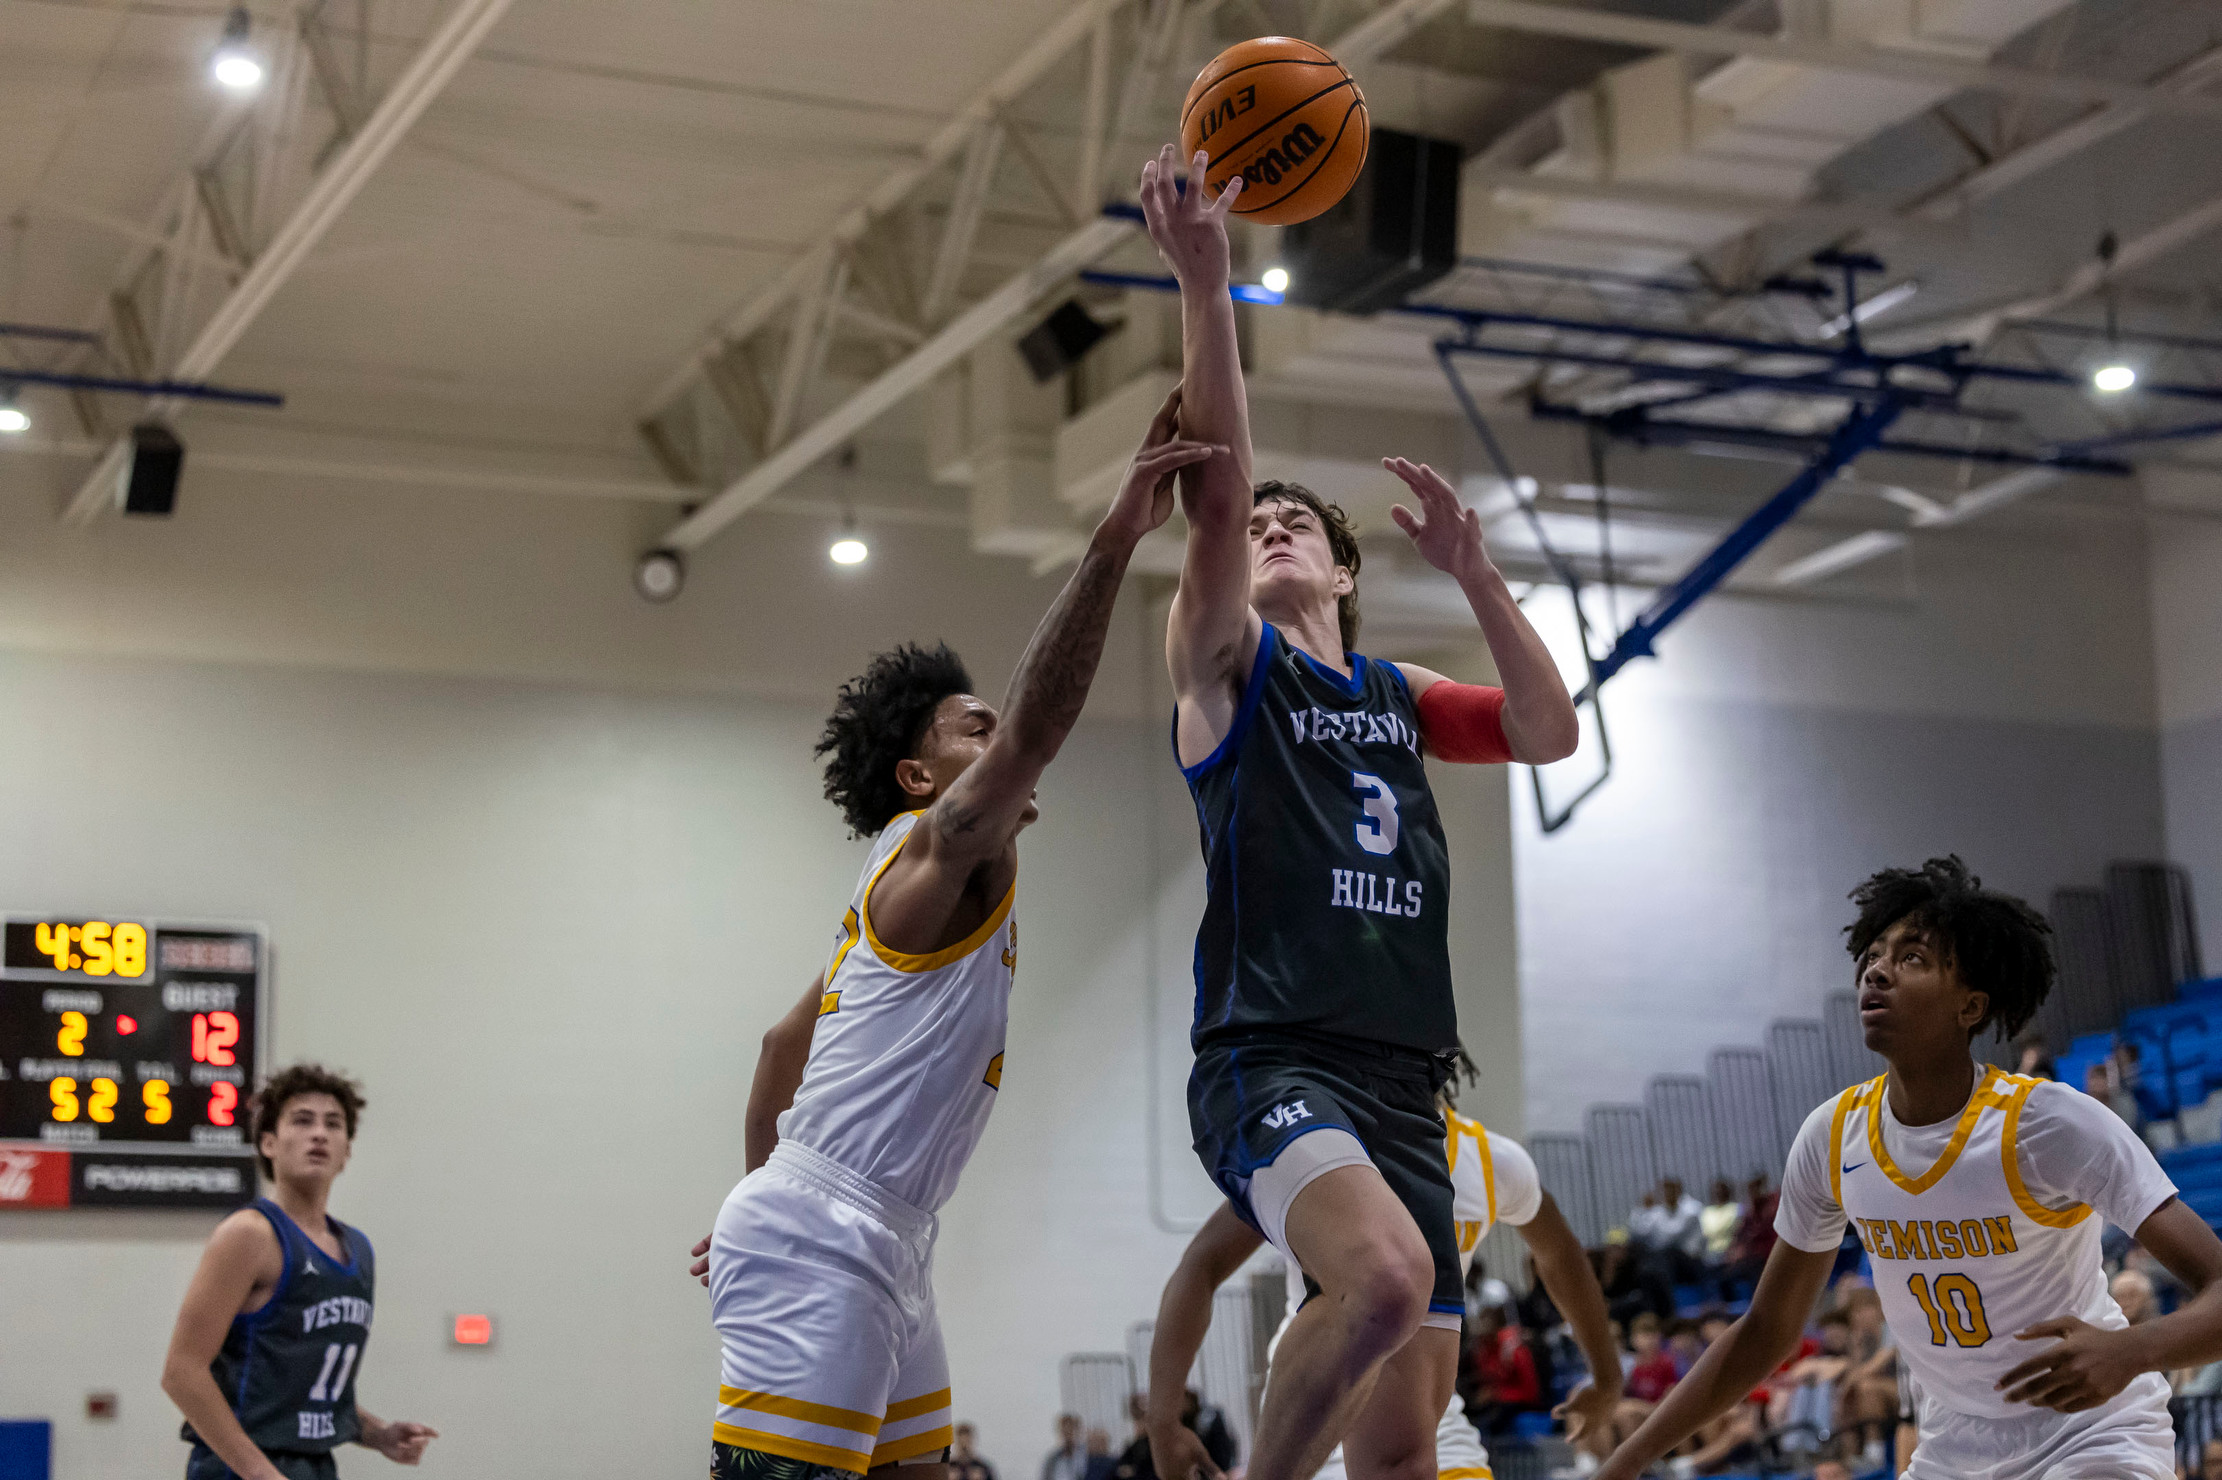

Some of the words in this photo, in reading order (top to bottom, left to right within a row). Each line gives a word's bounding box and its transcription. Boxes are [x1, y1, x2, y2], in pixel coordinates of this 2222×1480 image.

[1200, 84, 1256, 142] EVO
[1352, 771, 1400, 856] 3
[1331, 868, 1423, 918] HILLS
[35, 921, 147, 977] 4:58
[57, 1011, 88, 1056] 2
[191, 1011, 240, 1066] 12
[142, 1079, 172, 1125] 5
[207, 1080, 238, 1126] 2
[1261, 1100, 1313, 1129] VH
[1907, 1272, 1993, 1348] 10
[309, 1343, 358, 1401] 11
